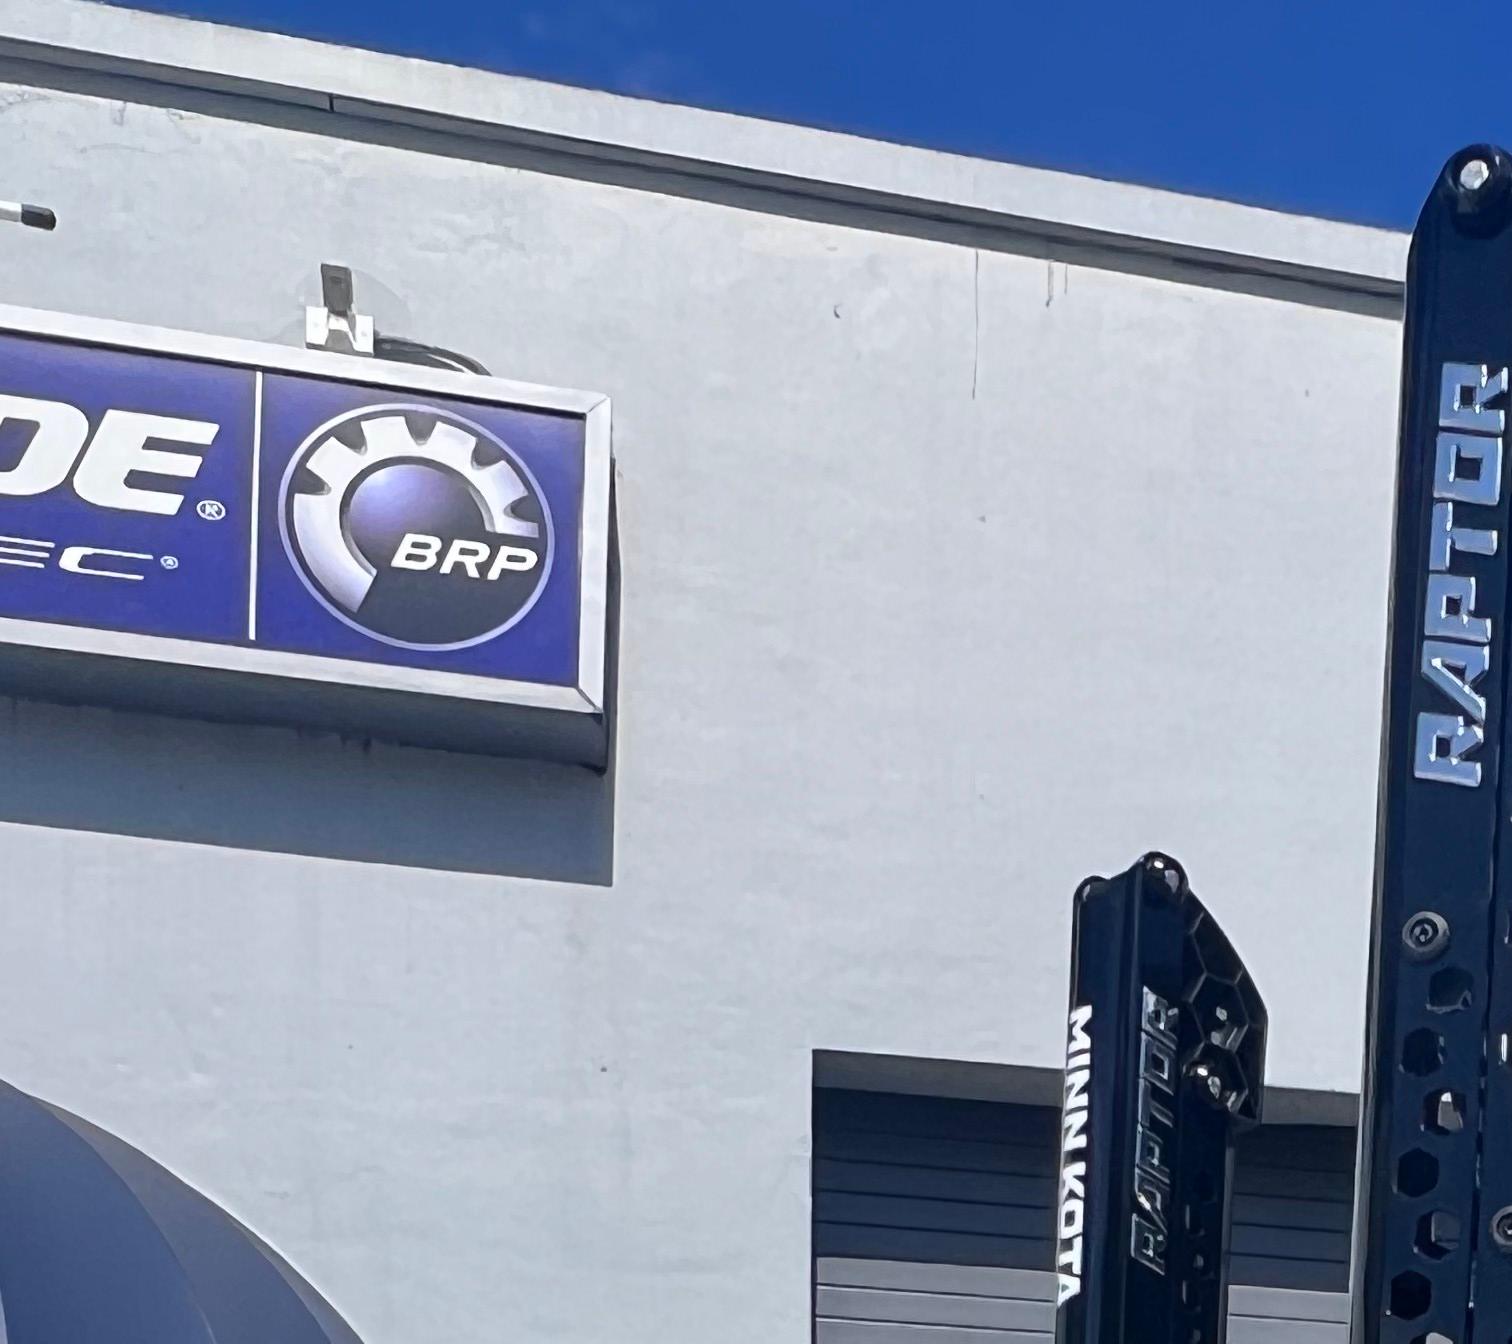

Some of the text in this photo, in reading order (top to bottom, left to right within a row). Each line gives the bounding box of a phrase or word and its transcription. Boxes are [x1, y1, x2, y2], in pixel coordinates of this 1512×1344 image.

[389, 532, 539, 582] BRP
[1413, 360, 1509, 788] RAPTOR
[1056, 1004, 1093, 1310] MINN KOTA
[1130, 984, 1180, 1277] RAPTOR
